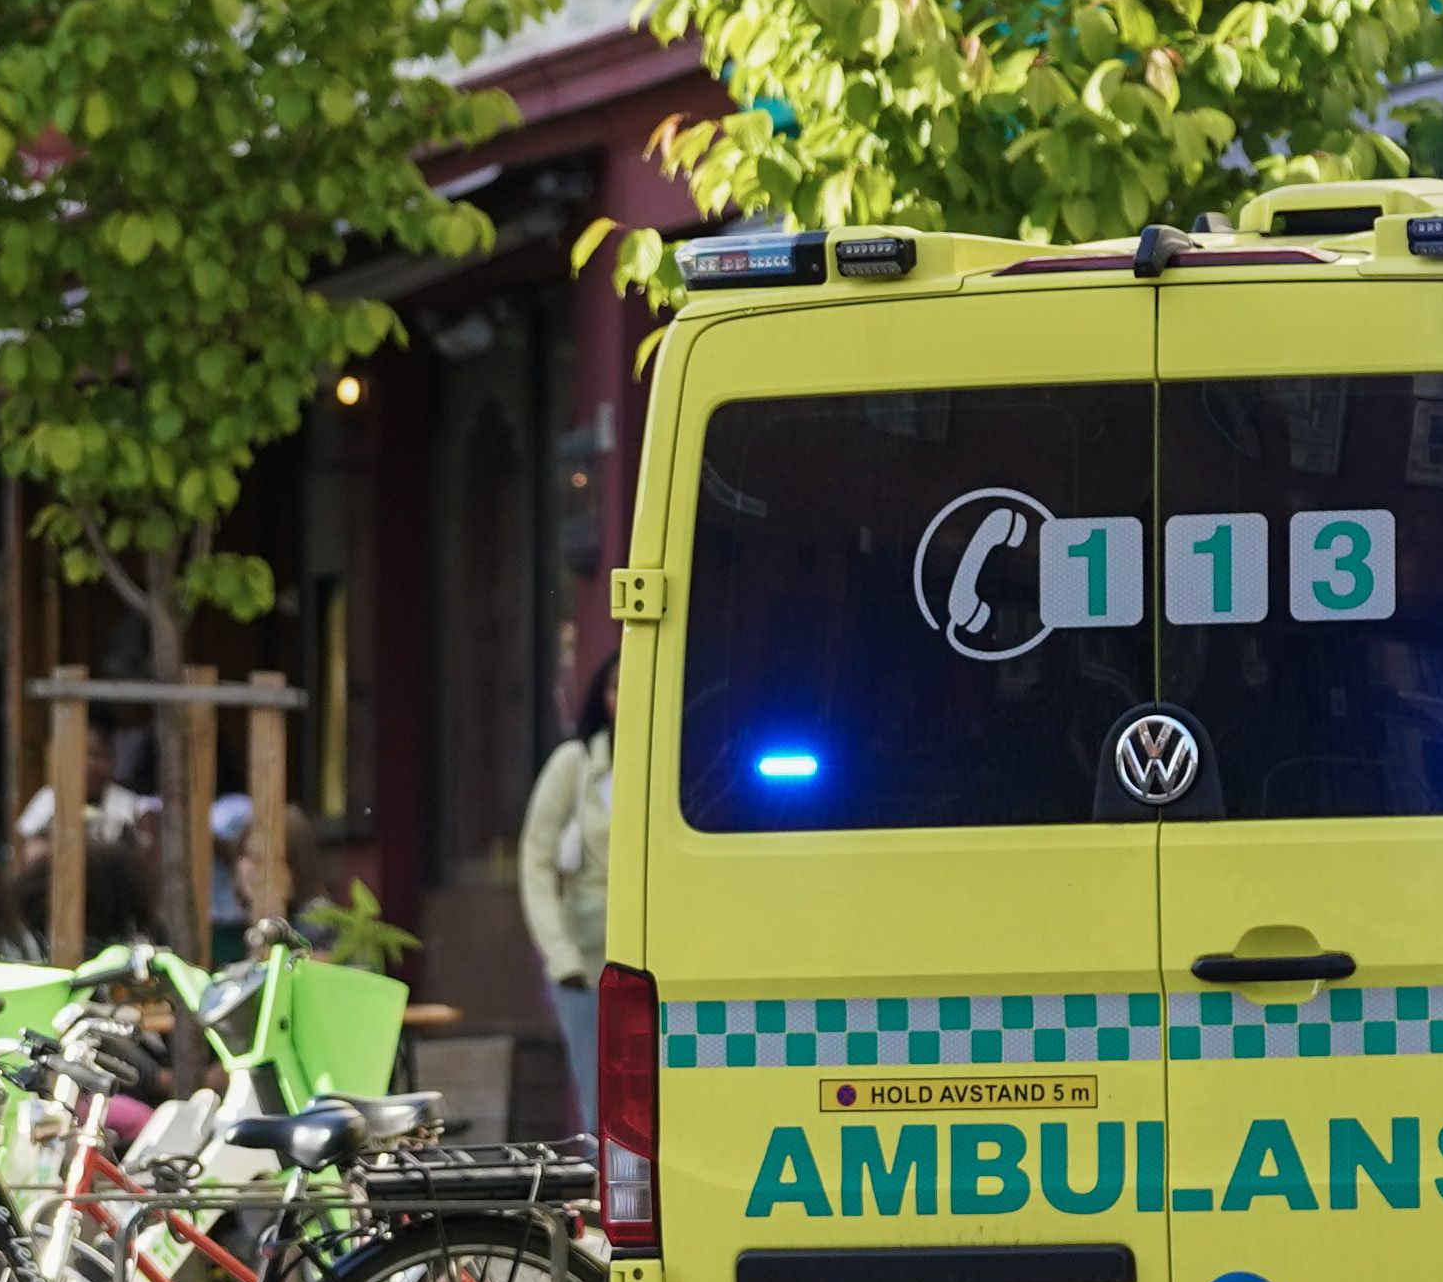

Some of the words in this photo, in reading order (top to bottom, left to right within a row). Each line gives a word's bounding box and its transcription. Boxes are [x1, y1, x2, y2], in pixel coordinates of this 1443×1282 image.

[871, 1085, 933, 1104] HOLD
[939, 1083, 1045, 1103] AVSTAND
[1053, 1084, 1065, 1101] 5
[1071, 1088, 1090, 1101] m
